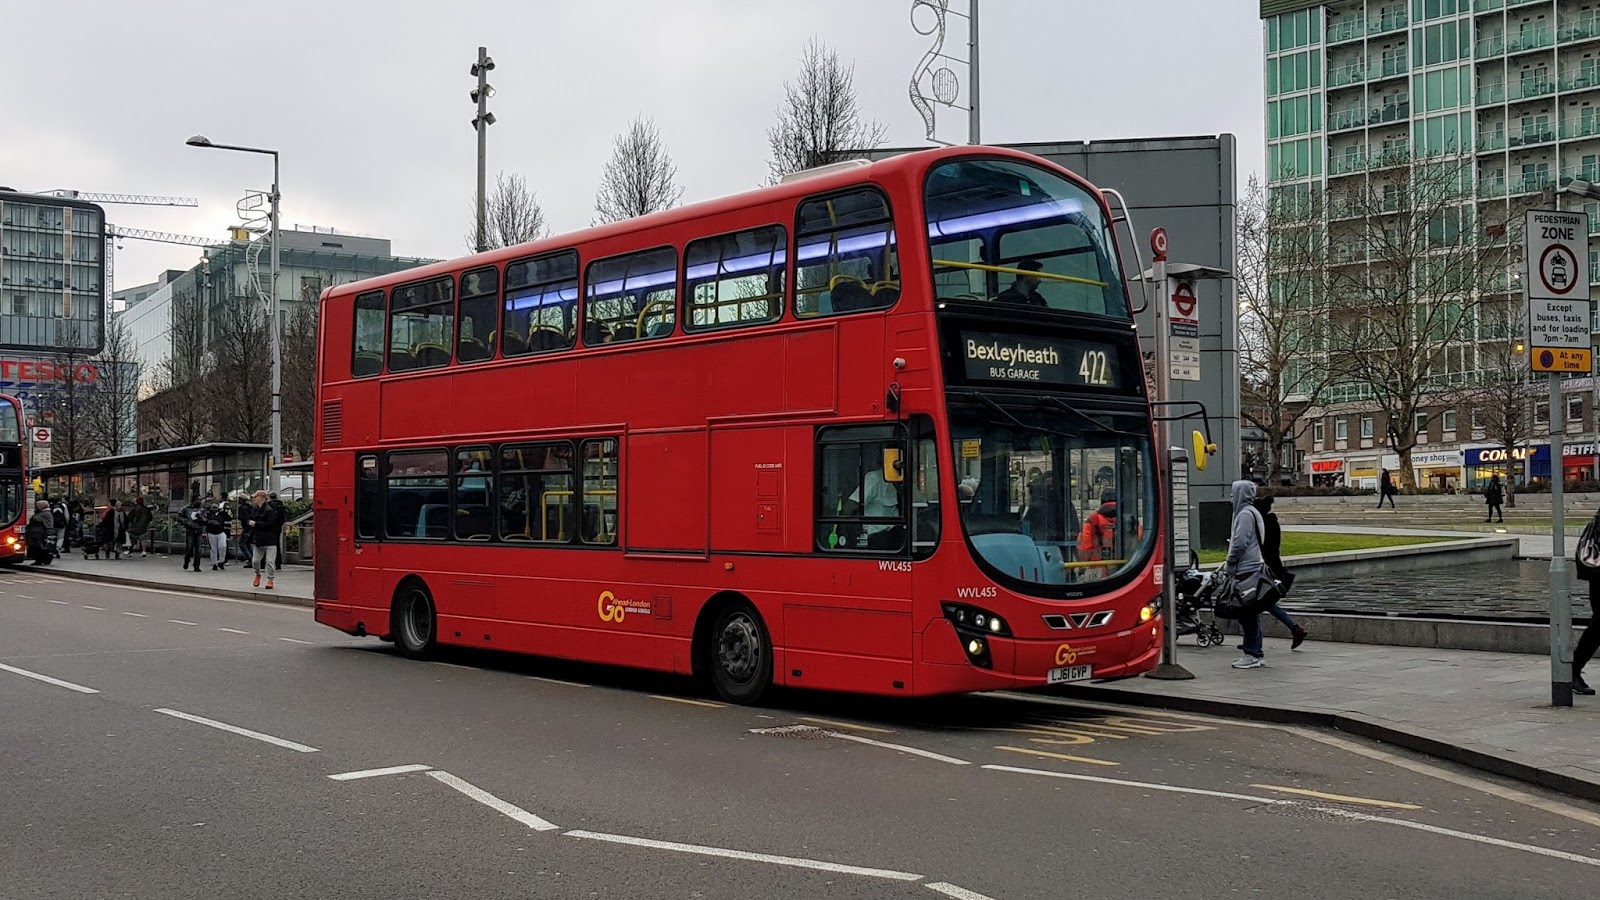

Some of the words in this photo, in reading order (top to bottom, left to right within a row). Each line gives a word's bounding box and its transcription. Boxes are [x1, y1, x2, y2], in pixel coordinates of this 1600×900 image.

[1534, 215, 1580, 225] PEDESTRIAN
[1542, 226, 1574, 240] ZONE
[1155, 233, 1166, 251] Q
[1547, 303, 1572, 312] Except
[1537, 313, 1560, 322] buses,
[1564, 314, 1582, 322] taxis
[1532, 324, 1546, 332] and
[1549, 324, 1560, 332] for
[1562, 324, 1588, 334] loading
[967, 339, 1059, 366] Bexleyheath
[1078, 350, 1107, 384] 422
[1571, 352, 1583, 361] any
[0, 360, 97, 382] TESCO
[990, 367, 1006, 378] BUS
[1008, 368, 1040, 380] GARAGE
[1312, 460, 1343, 472] WIMPY
[879, 561, 912, 572] WVL455
[957, 587, 997, 598] WVL455
[598, 590, 625, 623] Go
[1055, 644, 1077, 665] Go
[1052, 669, 1070, 680] LJ61
[1071, 667, 1087, 679] GVP
